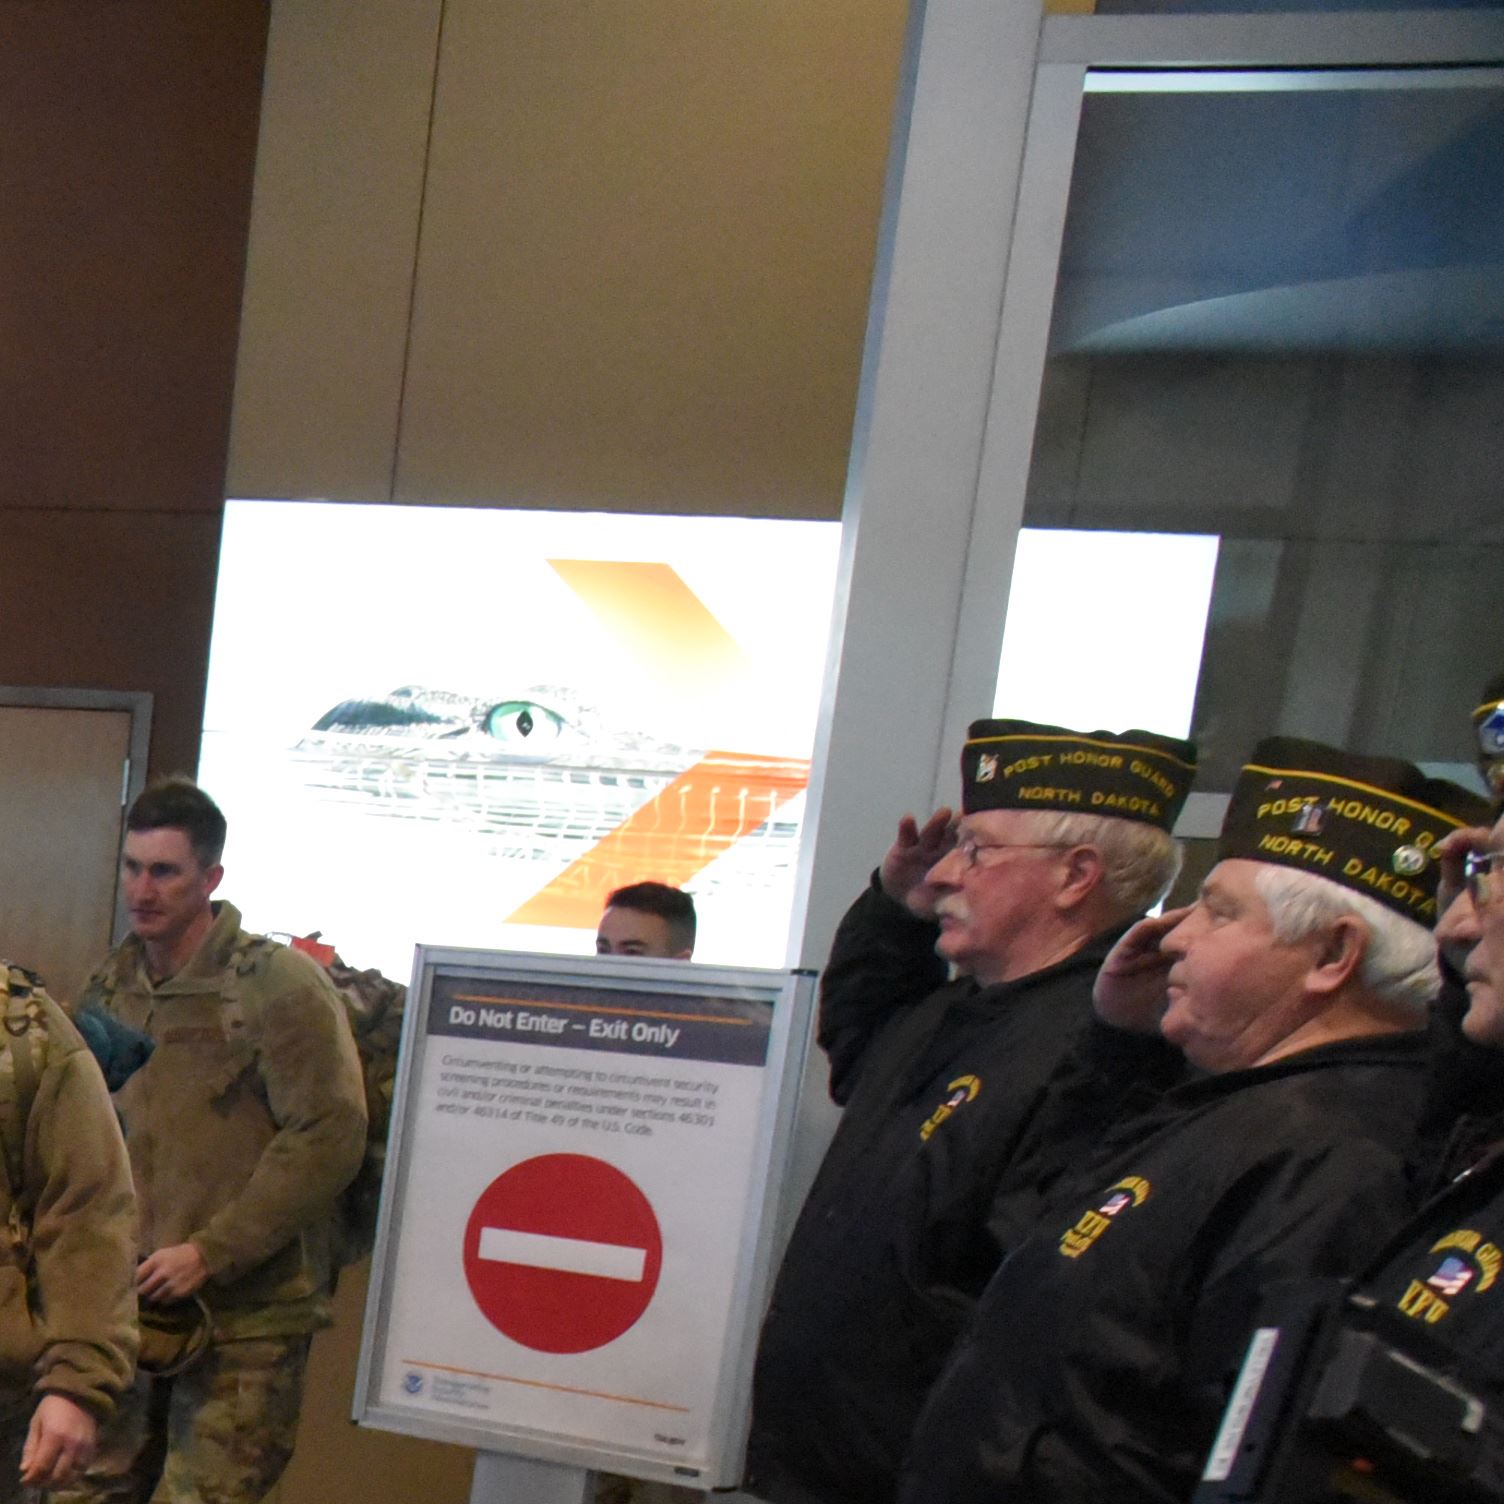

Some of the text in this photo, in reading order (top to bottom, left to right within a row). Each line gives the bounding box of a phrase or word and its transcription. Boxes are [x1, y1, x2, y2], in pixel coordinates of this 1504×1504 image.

[1003, 750, 1176, 798] POST HONOR GUARD
[1018, 786, 1161, 817] NORTH DAKOTA
[1327, 798, 1412, 836] HONOR
[1258, 834, 1438, 917] NORTH DAKOTA
[449, 1005, 476, 1025] Do
[478, 1009, 513, 1031] Not
[516, 1012, 569, 1034] Enter
[589, 1018, 629, 1040] Exit
[631, 1023, 680, 1047] Only
